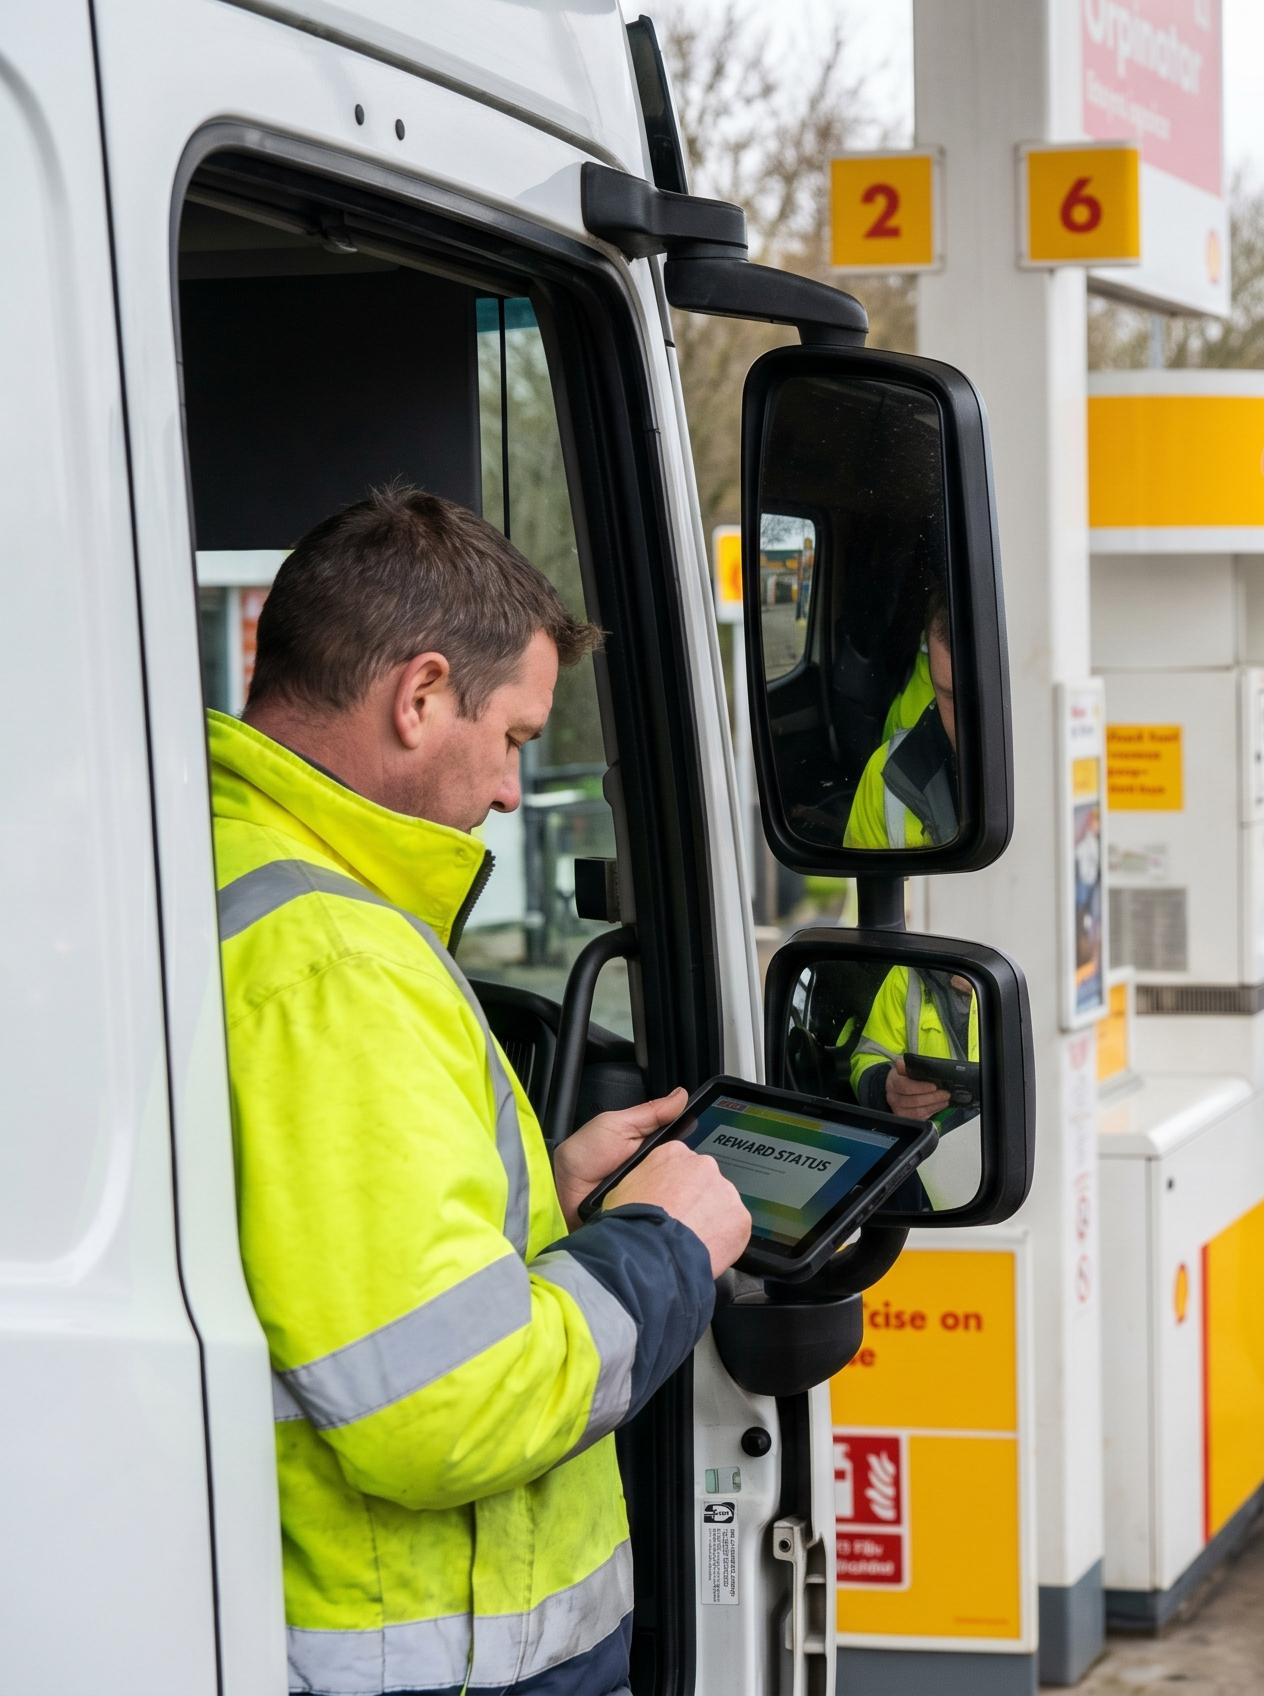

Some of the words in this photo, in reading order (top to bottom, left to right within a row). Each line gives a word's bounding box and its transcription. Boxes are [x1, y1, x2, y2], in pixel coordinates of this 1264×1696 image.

[861, 182, 901, 239] 2
[1060, 176, 1102, 234] 6
[713, 1134, 775, 1157] REWARD
[773, 1150, 832, 1172] STATUS
[864, 1300, 927, 1331] cise
[940, 1311, 984, 1332] on
